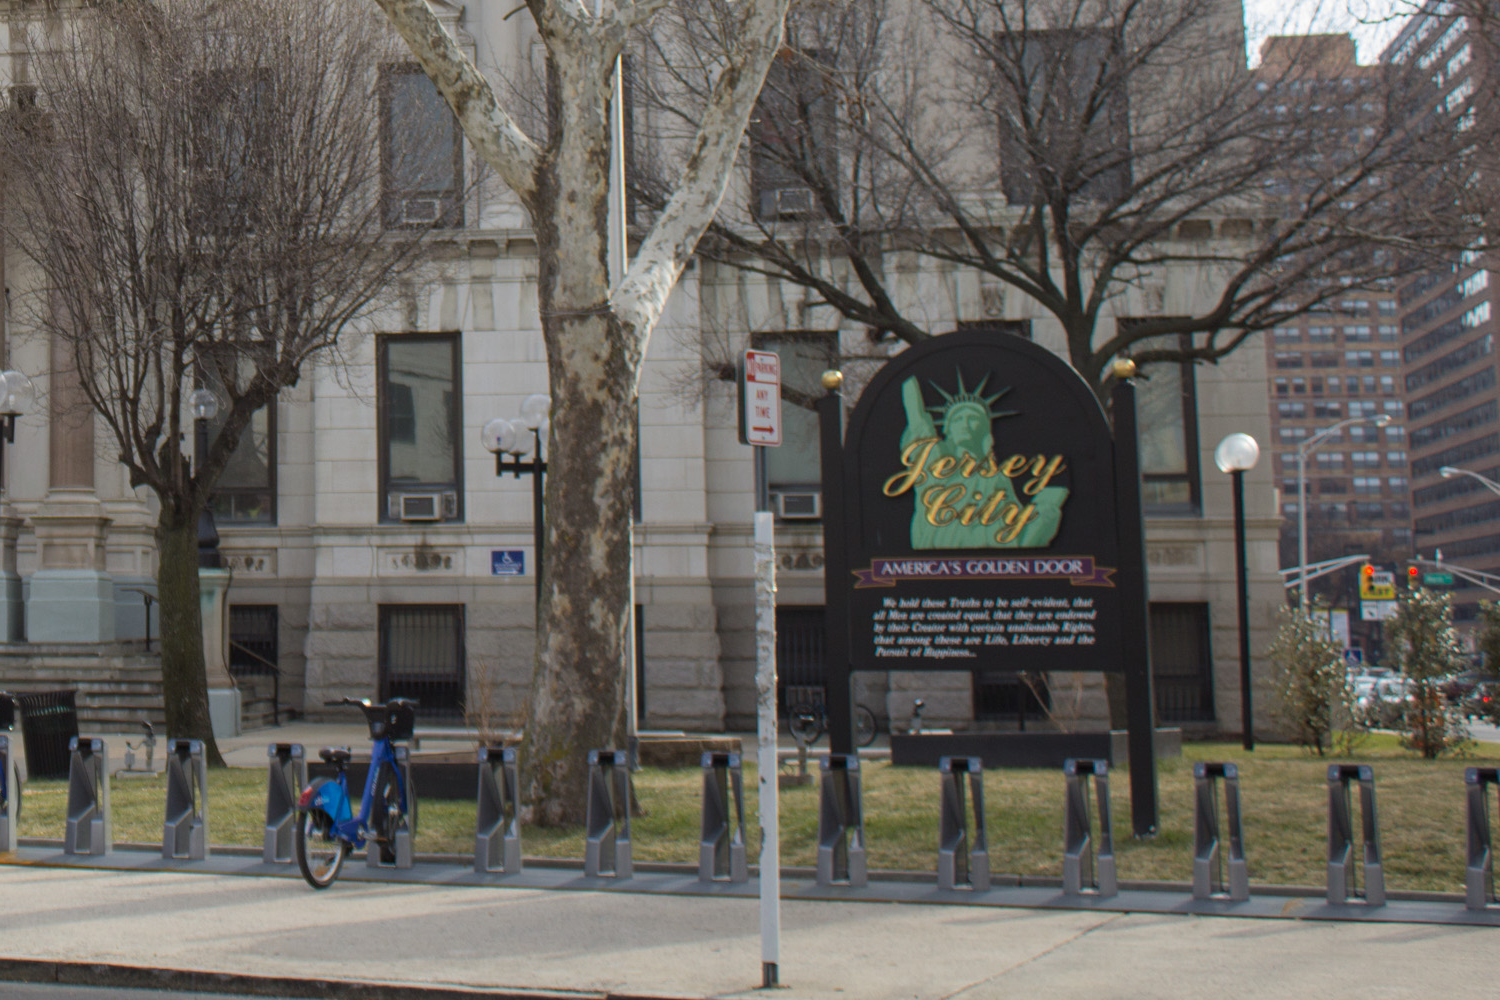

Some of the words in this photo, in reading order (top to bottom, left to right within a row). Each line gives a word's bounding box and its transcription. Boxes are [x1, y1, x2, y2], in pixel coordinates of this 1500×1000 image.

[755, 363, 778, 376] PARKING
[756, 389, 768, 400] ANY
[755, 406, 771, 419] TIME
[882, 437, 1067, 497] Jersey
[922, 483, 1039, 544] City
[881, 561, 962, 575] AMERICA'S
[966, 560, 1030, 575] GOLDEN
[1034, 560, 1084, 574] DOOR
[882, 597, 897, 608] We
